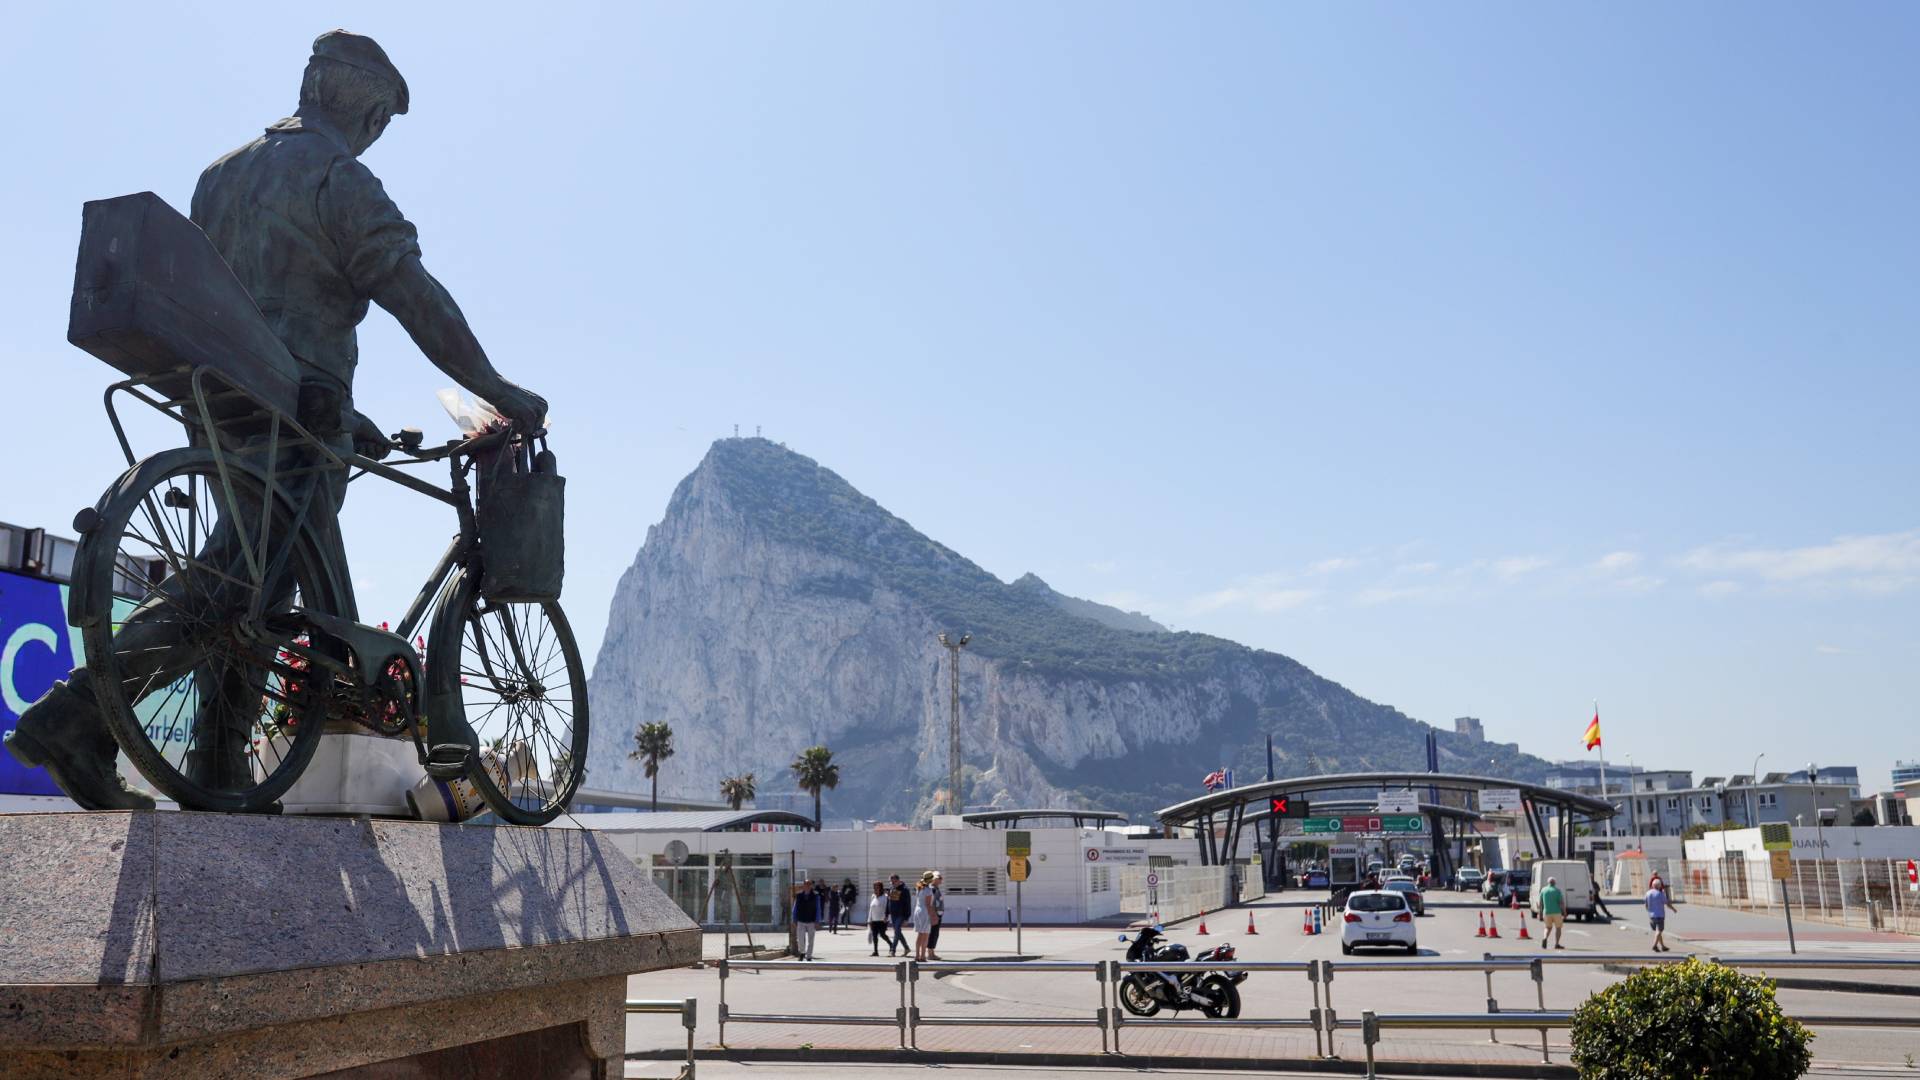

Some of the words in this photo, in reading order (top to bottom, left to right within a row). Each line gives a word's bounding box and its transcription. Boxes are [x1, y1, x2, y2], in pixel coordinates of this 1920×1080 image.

[0, 622, 58, 718] C
[144, 714, 193, 743] arbell
[1793, 839, 1830, 848] UANA
